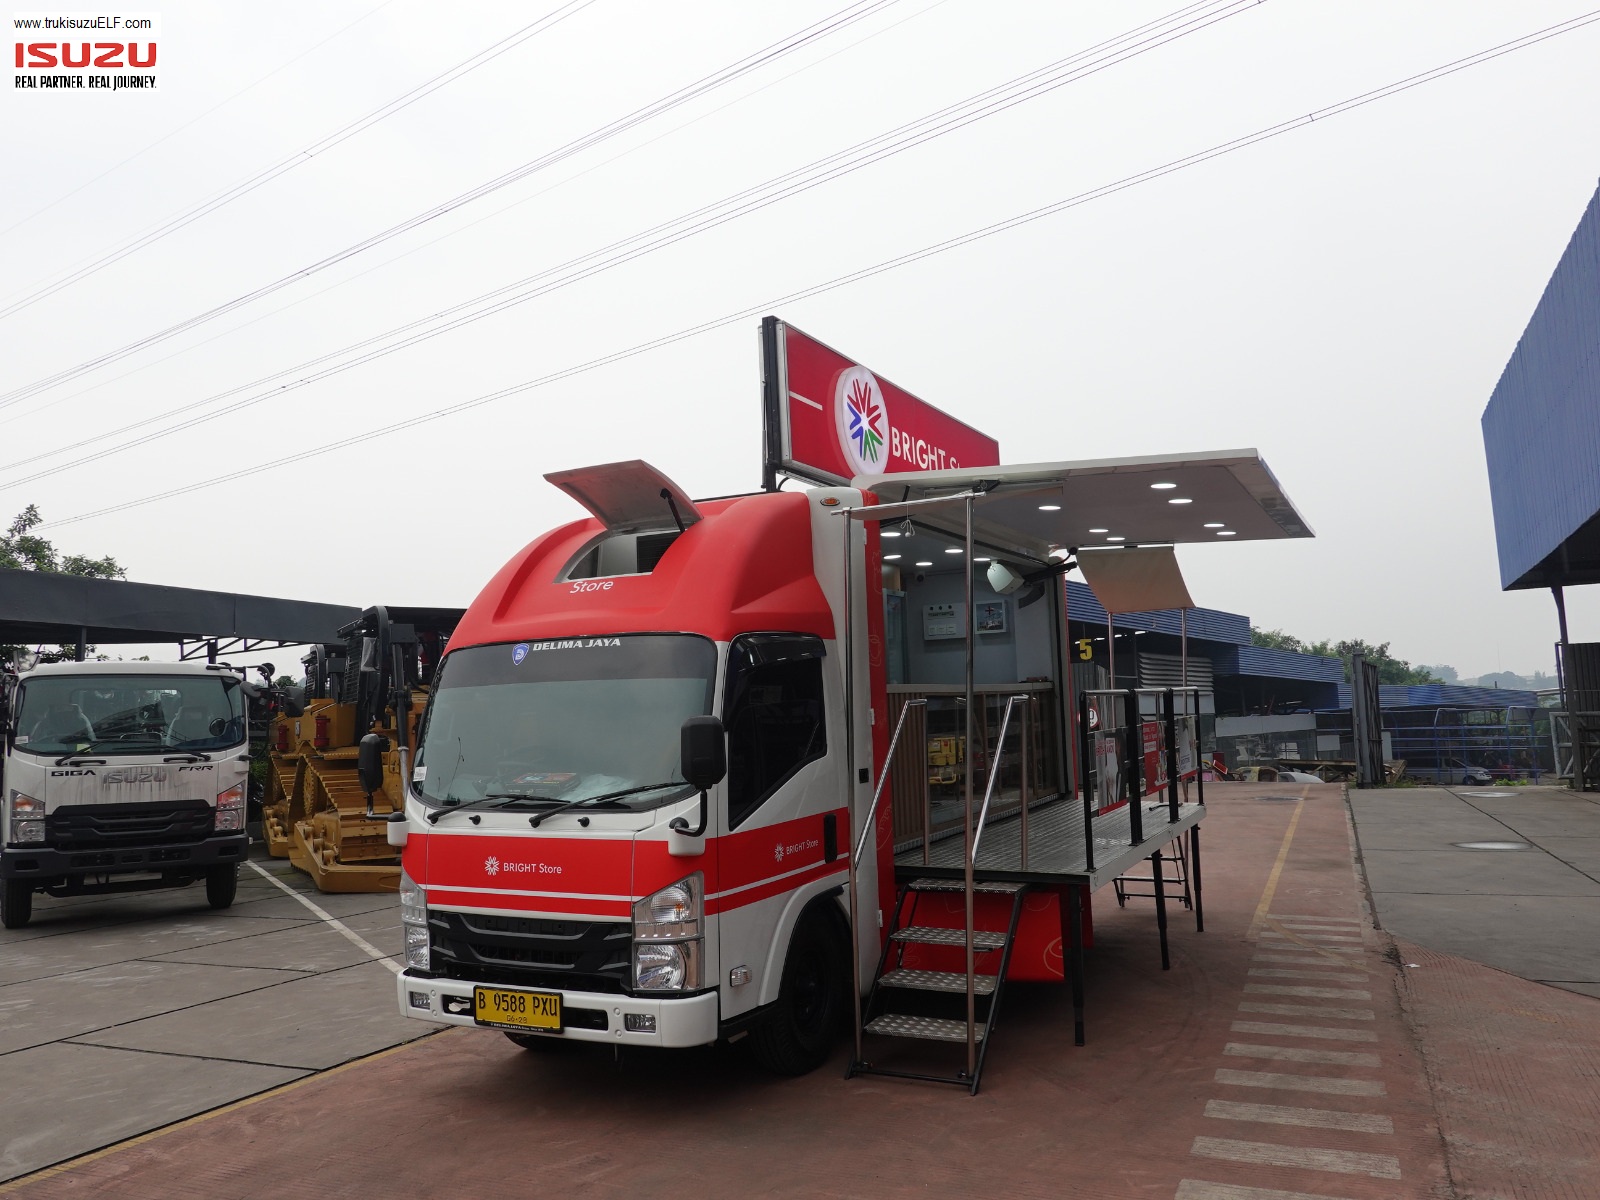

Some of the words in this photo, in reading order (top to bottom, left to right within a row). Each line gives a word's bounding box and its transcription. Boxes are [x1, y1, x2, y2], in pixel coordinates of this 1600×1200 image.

[891, 426, 946, 471] BRIGHT
[570, 581, 614, 594] Store
[533, 640, 583, 651] DELIMA
[585, 638, 621, 649] JAYA
[1079, 638, 1093, 661] 5
[51, 769, 97, 777] GIGA
[178, 764, 214, 772] FRR
[103, 772, 167, 784] ISUZU
[786, 841, 806, 855] BRIGHT
[806, 839, 819, 849] Store
[503, 862, 537, 873] BRIGHT
[538, 862, 562, 874] Store
[478, 991, 486, 1009] B
[493, 993, 526, 1013] 9588
[532, 996, 558, 1017] PXU
